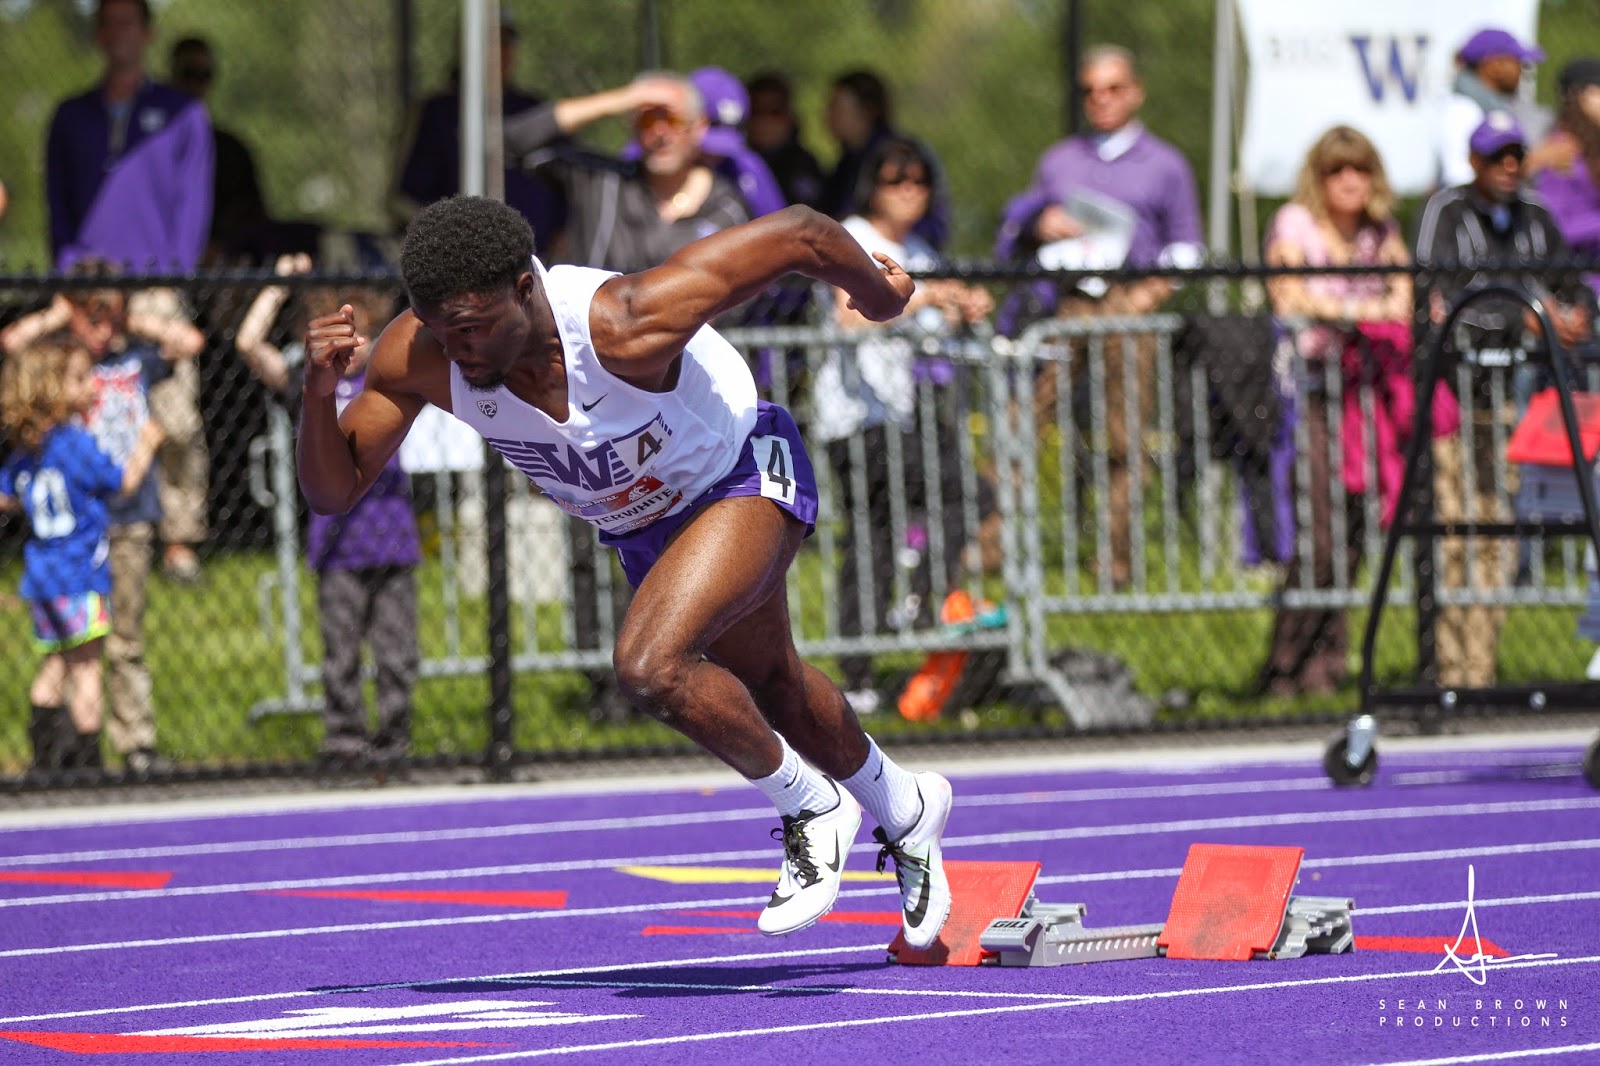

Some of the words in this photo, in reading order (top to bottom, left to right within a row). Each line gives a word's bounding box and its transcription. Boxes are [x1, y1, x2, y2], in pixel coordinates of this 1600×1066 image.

[1350, 35, 1428, 103] W
[522, 440, 616, 492] W
[637, 430, 664, 466] 4
[766, 439, 792, 498] 4
[990, 920, 1029, 928] GILL
